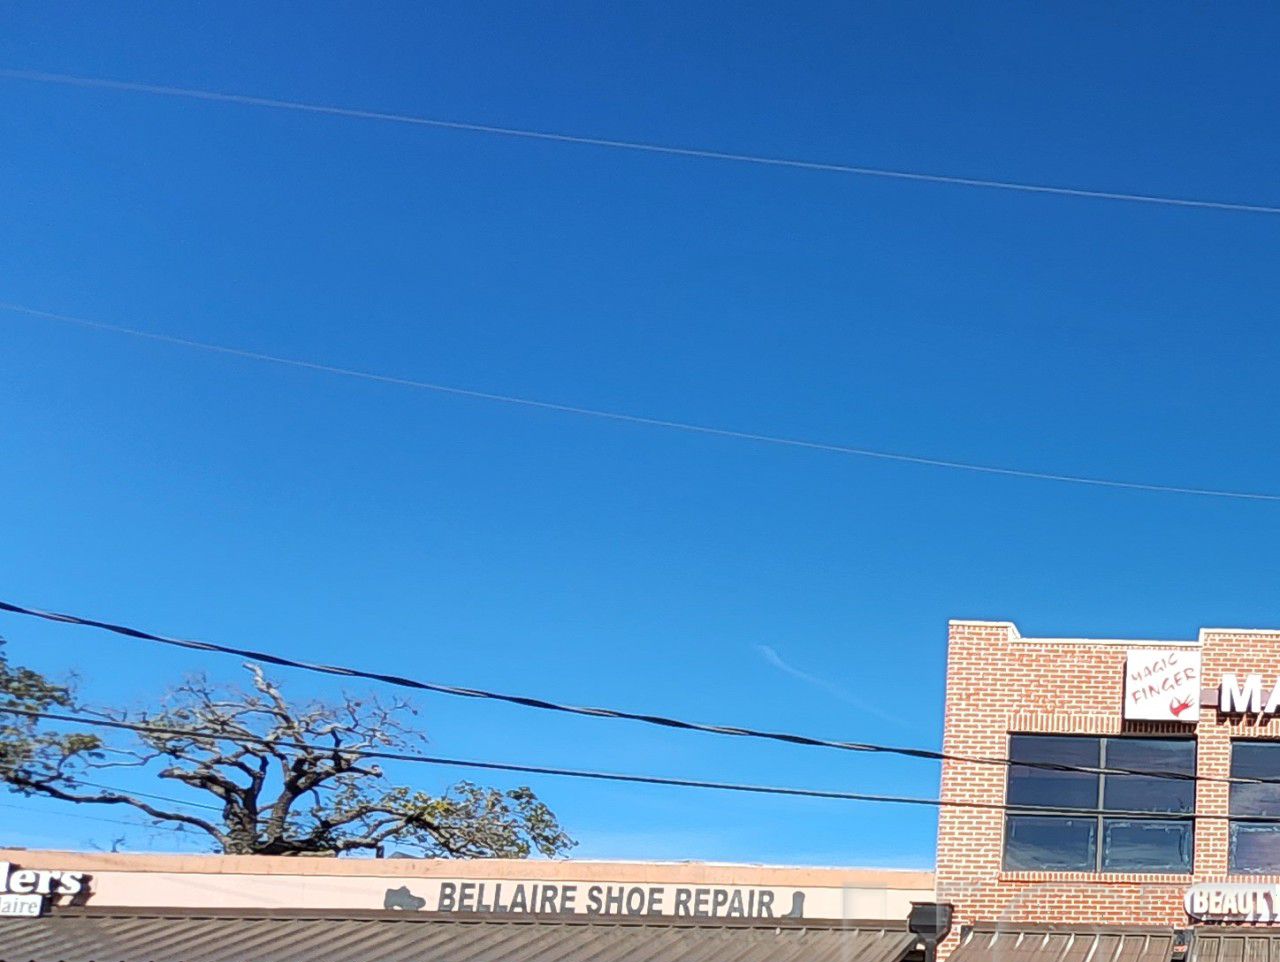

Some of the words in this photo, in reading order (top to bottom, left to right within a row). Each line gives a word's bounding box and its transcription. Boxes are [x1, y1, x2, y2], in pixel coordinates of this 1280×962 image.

[1132, 667, 1197, 704] FINGER
[438, 882, 577, 914] BELLAIRE
[586, 885, 664, 916] SHOE
[674, 887, 774, 918] REPAIR
